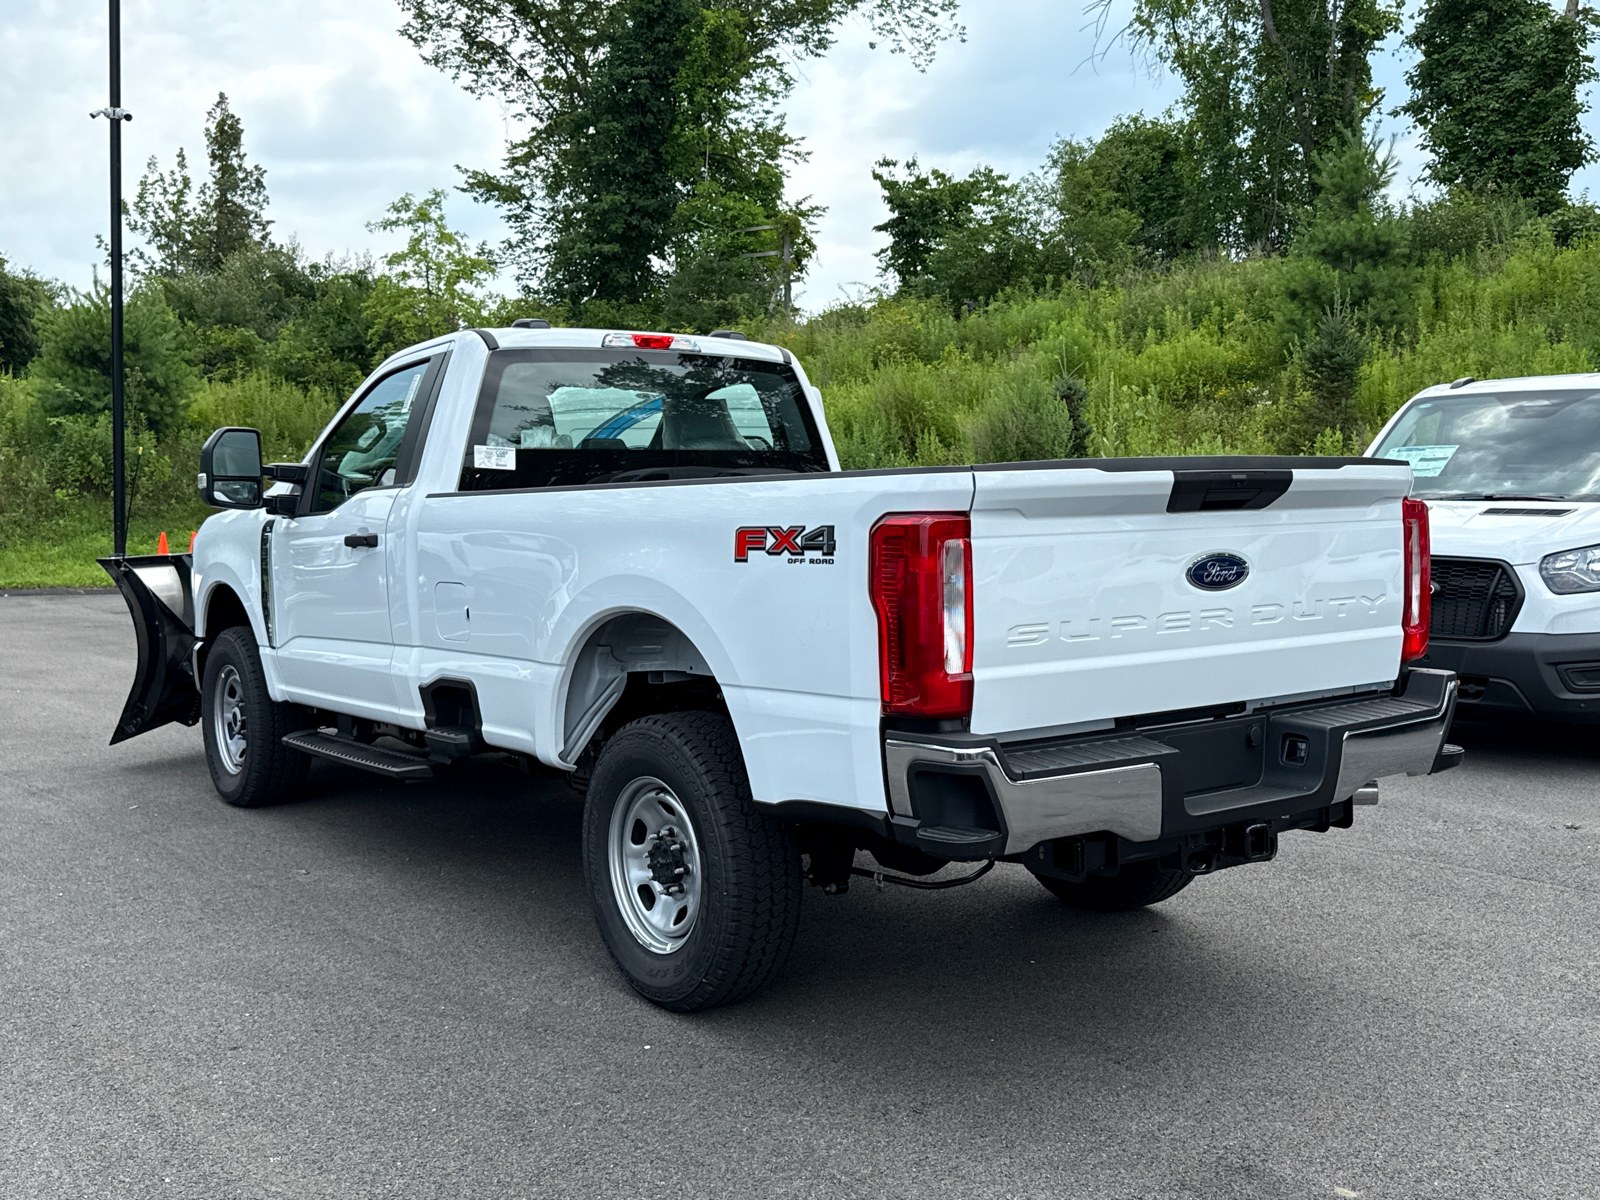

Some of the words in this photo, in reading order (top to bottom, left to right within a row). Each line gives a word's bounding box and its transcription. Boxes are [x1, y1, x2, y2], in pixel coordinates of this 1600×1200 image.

[734, 525, 836, 563] FX4
[1203, 561, 1237, 582] Ford
[1007, 607, 1234, 648] SUPER
[1252, 593, 1386, 625] DUTY
